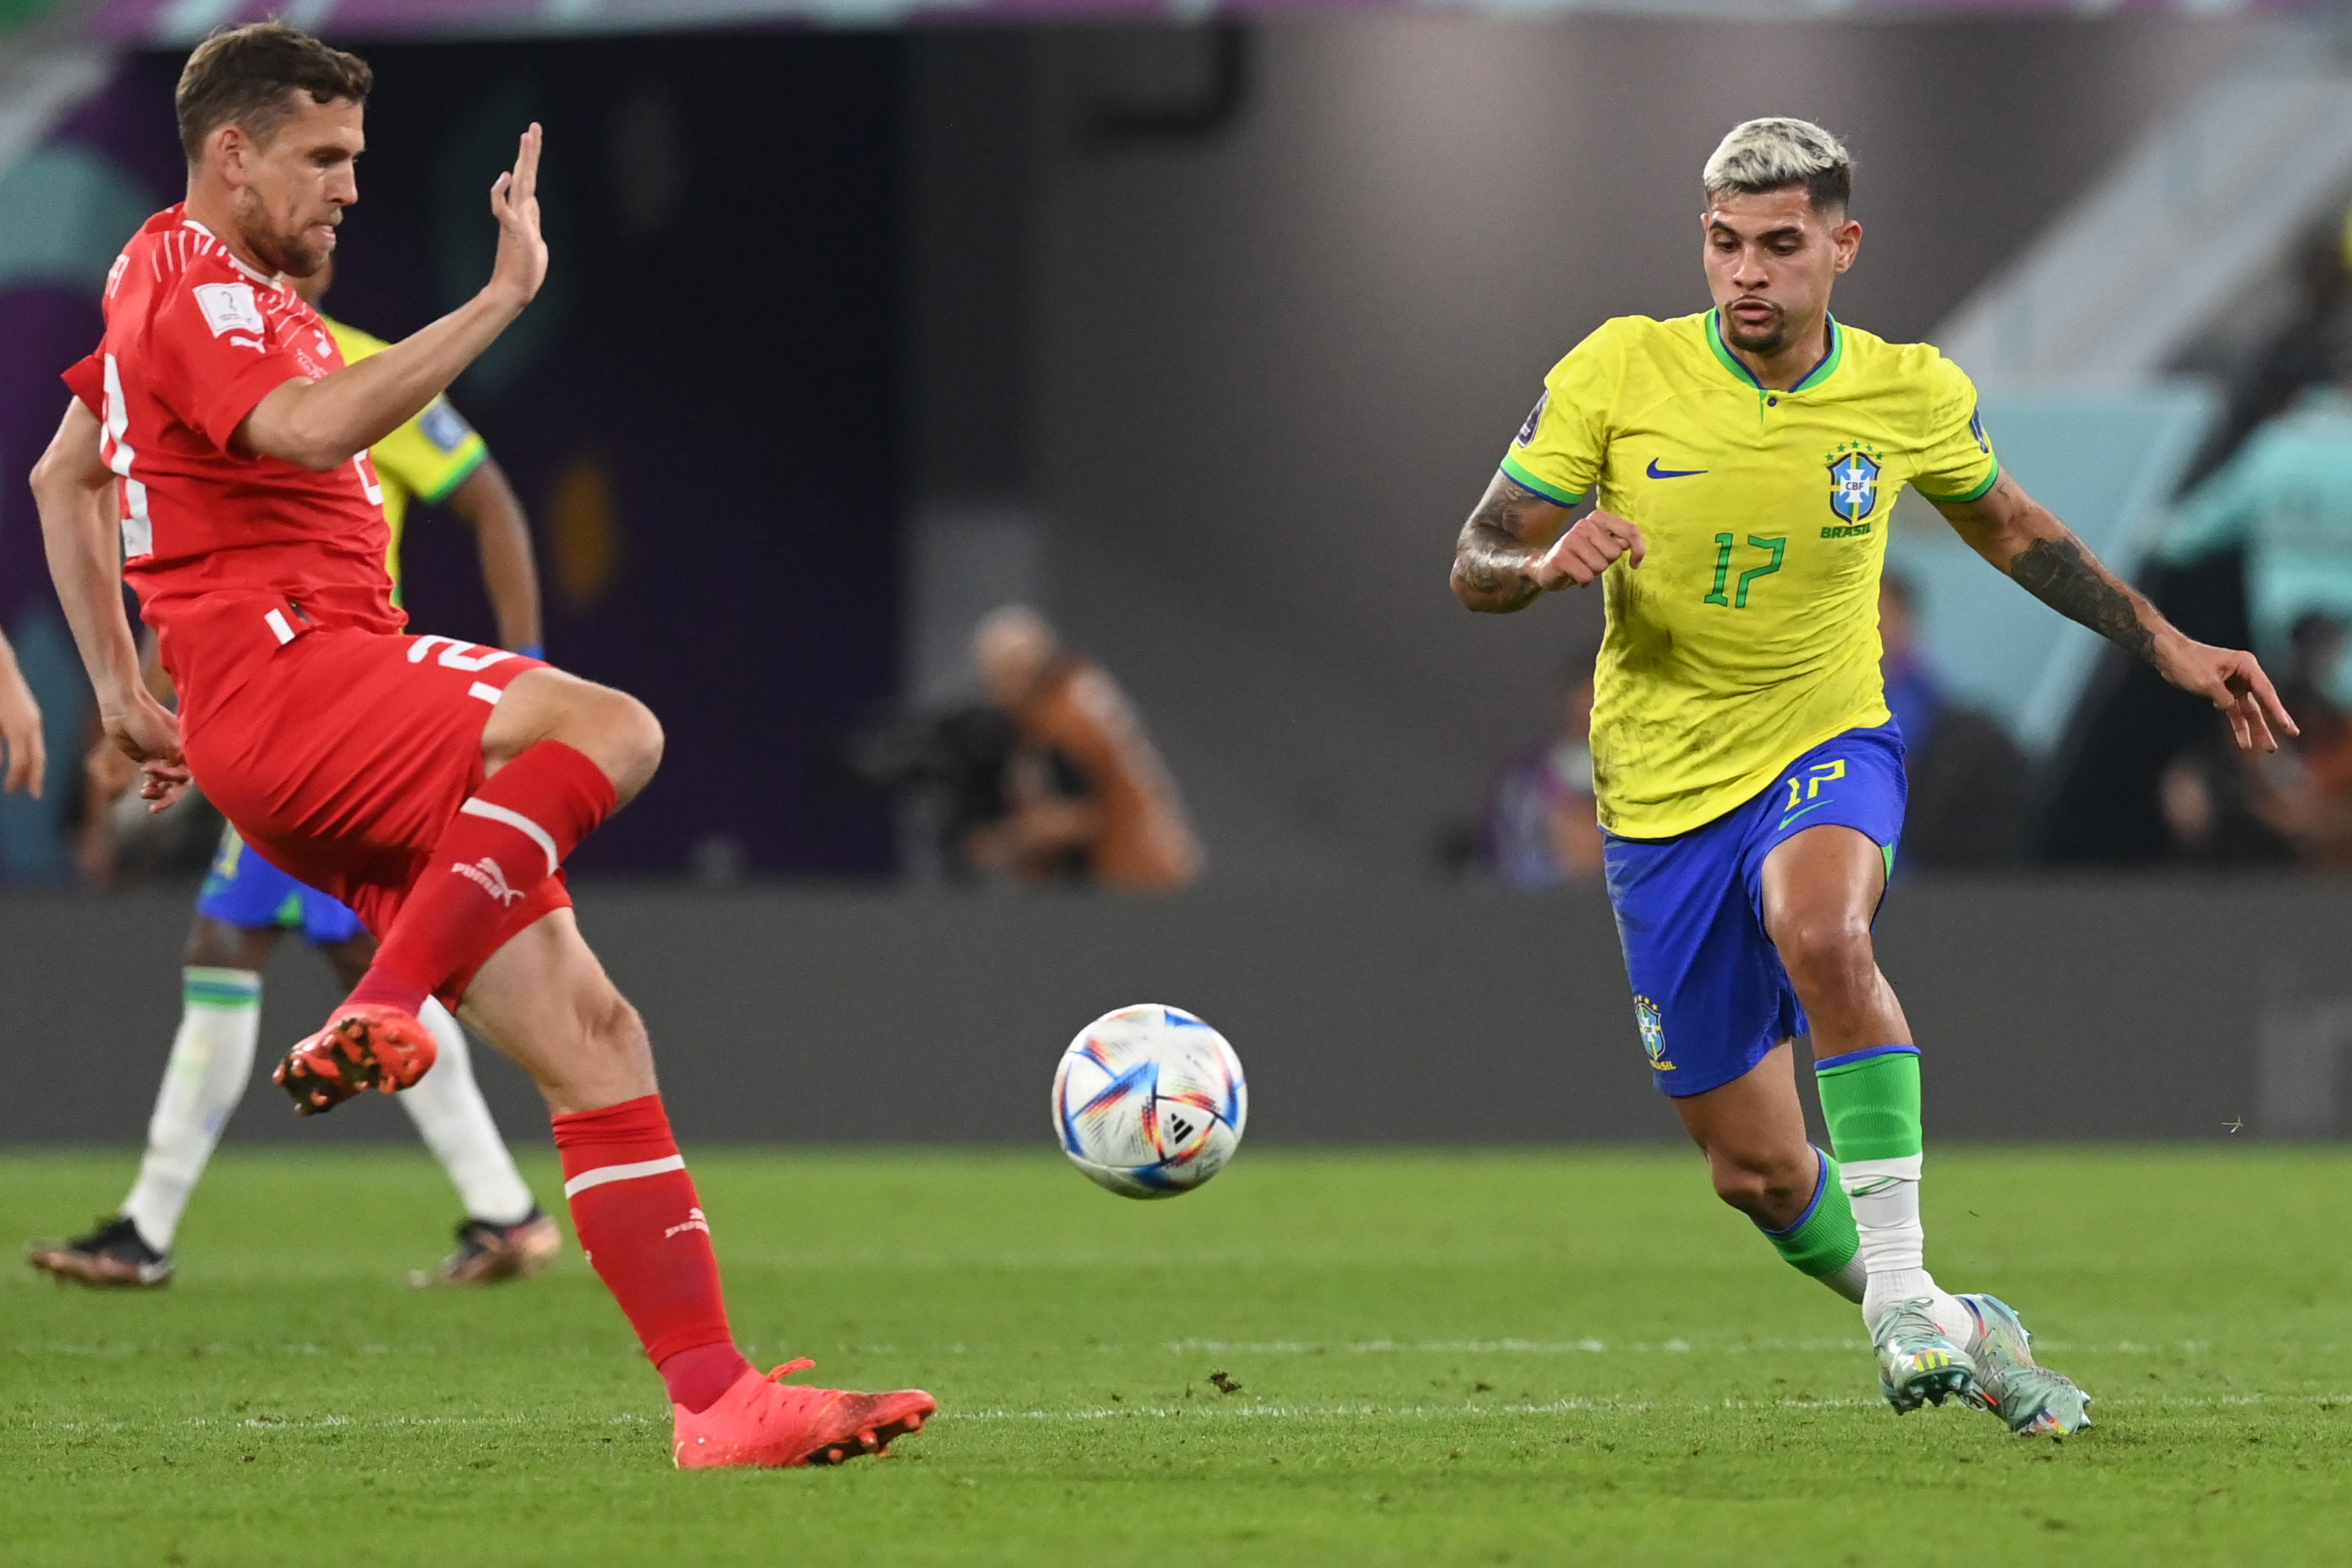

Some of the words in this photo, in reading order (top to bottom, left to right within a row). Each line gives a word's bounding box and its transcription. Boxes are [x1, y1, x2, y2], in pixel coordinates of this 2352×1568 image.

[1845, 481, 1864, 491] CBF
[1820, 523, 1871, 538] BRASIL
[1704, 532, 1787, 608] 17
[1784, 758, 1845, 812] 17
